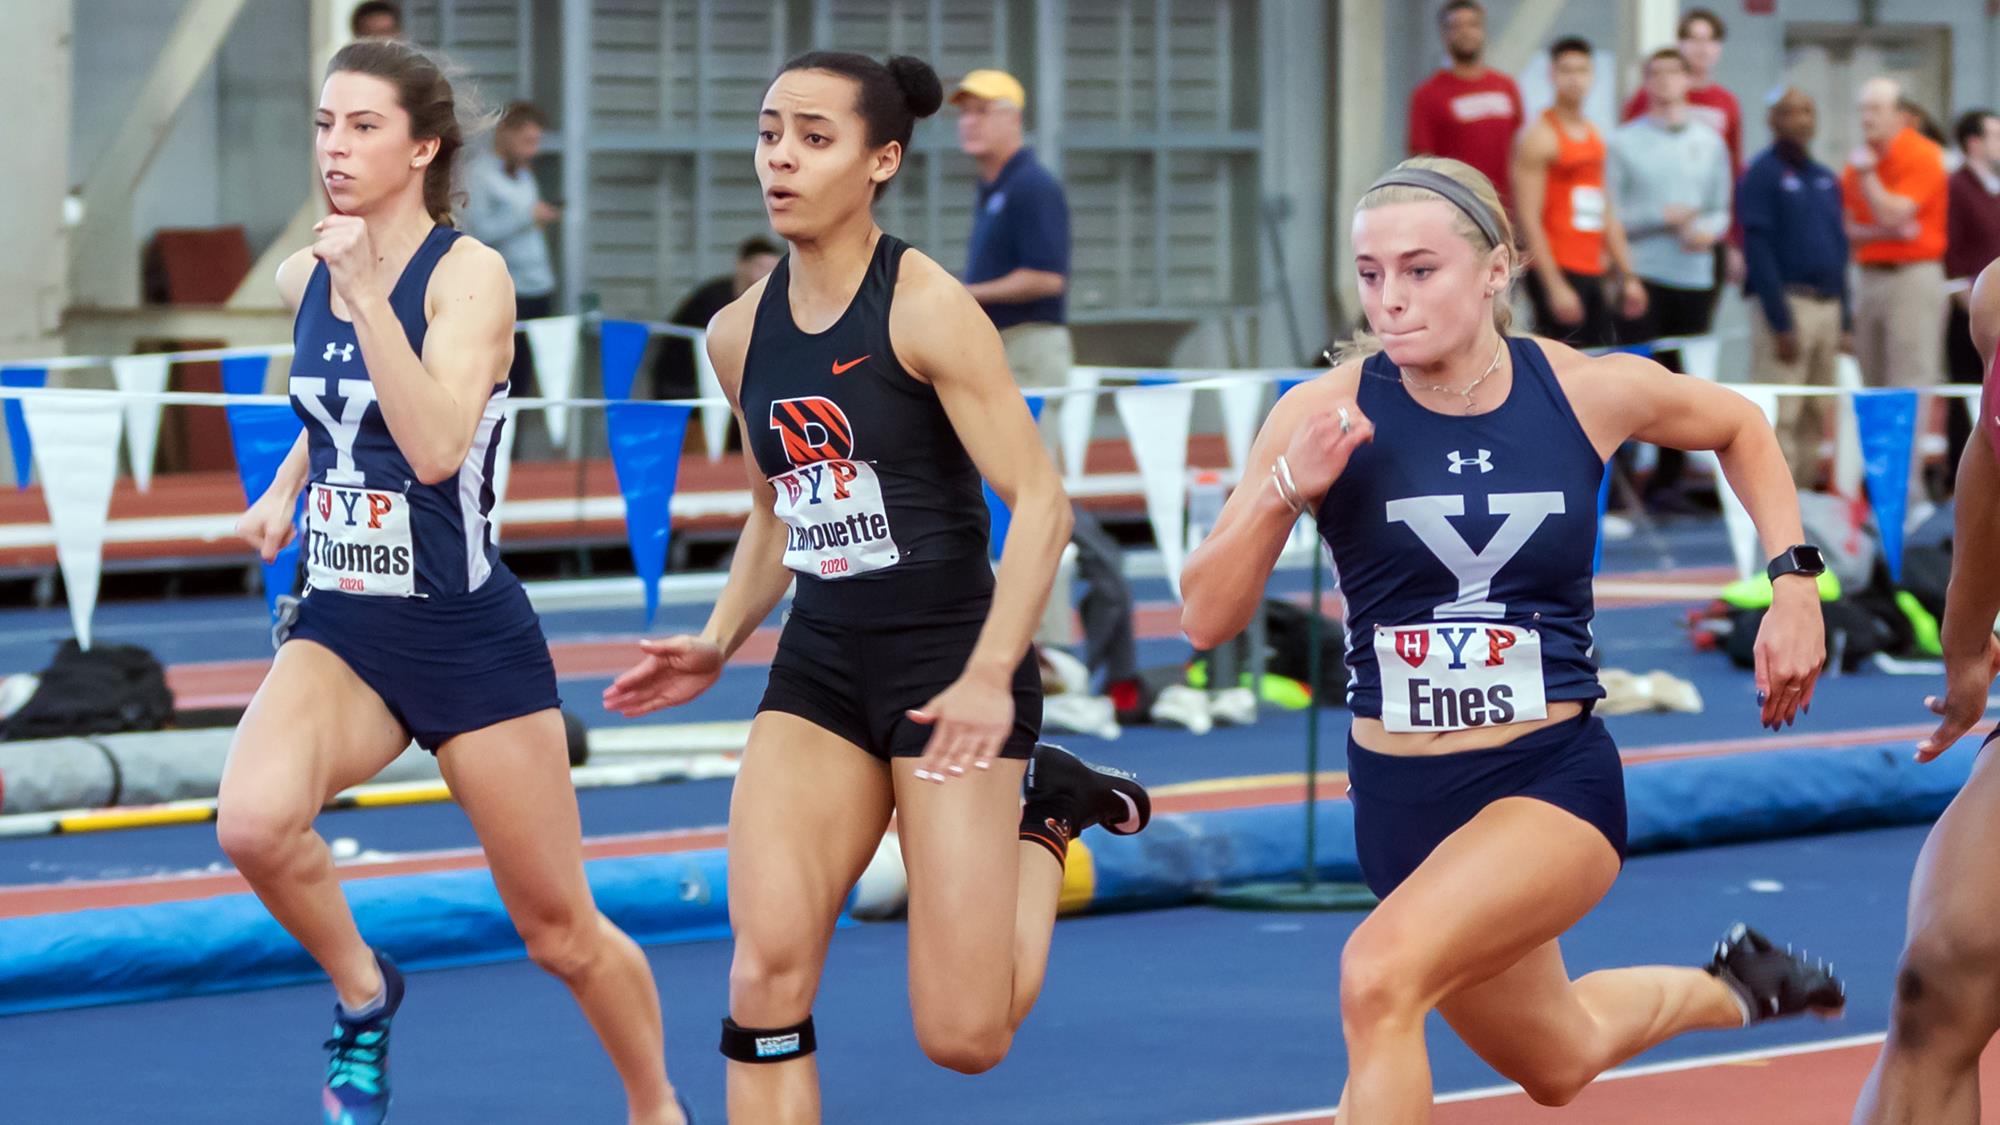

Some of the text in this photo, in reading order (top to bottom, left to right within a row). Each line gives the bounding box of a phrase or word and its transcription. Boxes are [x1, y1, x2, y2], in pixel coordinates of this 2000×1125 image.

[289, 376, 378, 487] Y
[311, 529, 410, 576] Thomas
[820, 557, 848, 575] 2020
[1386, 491, 1566, 620] Y
[339, 577, 364, 592] 2020
[1408, 678, 1515, 728] Enes
